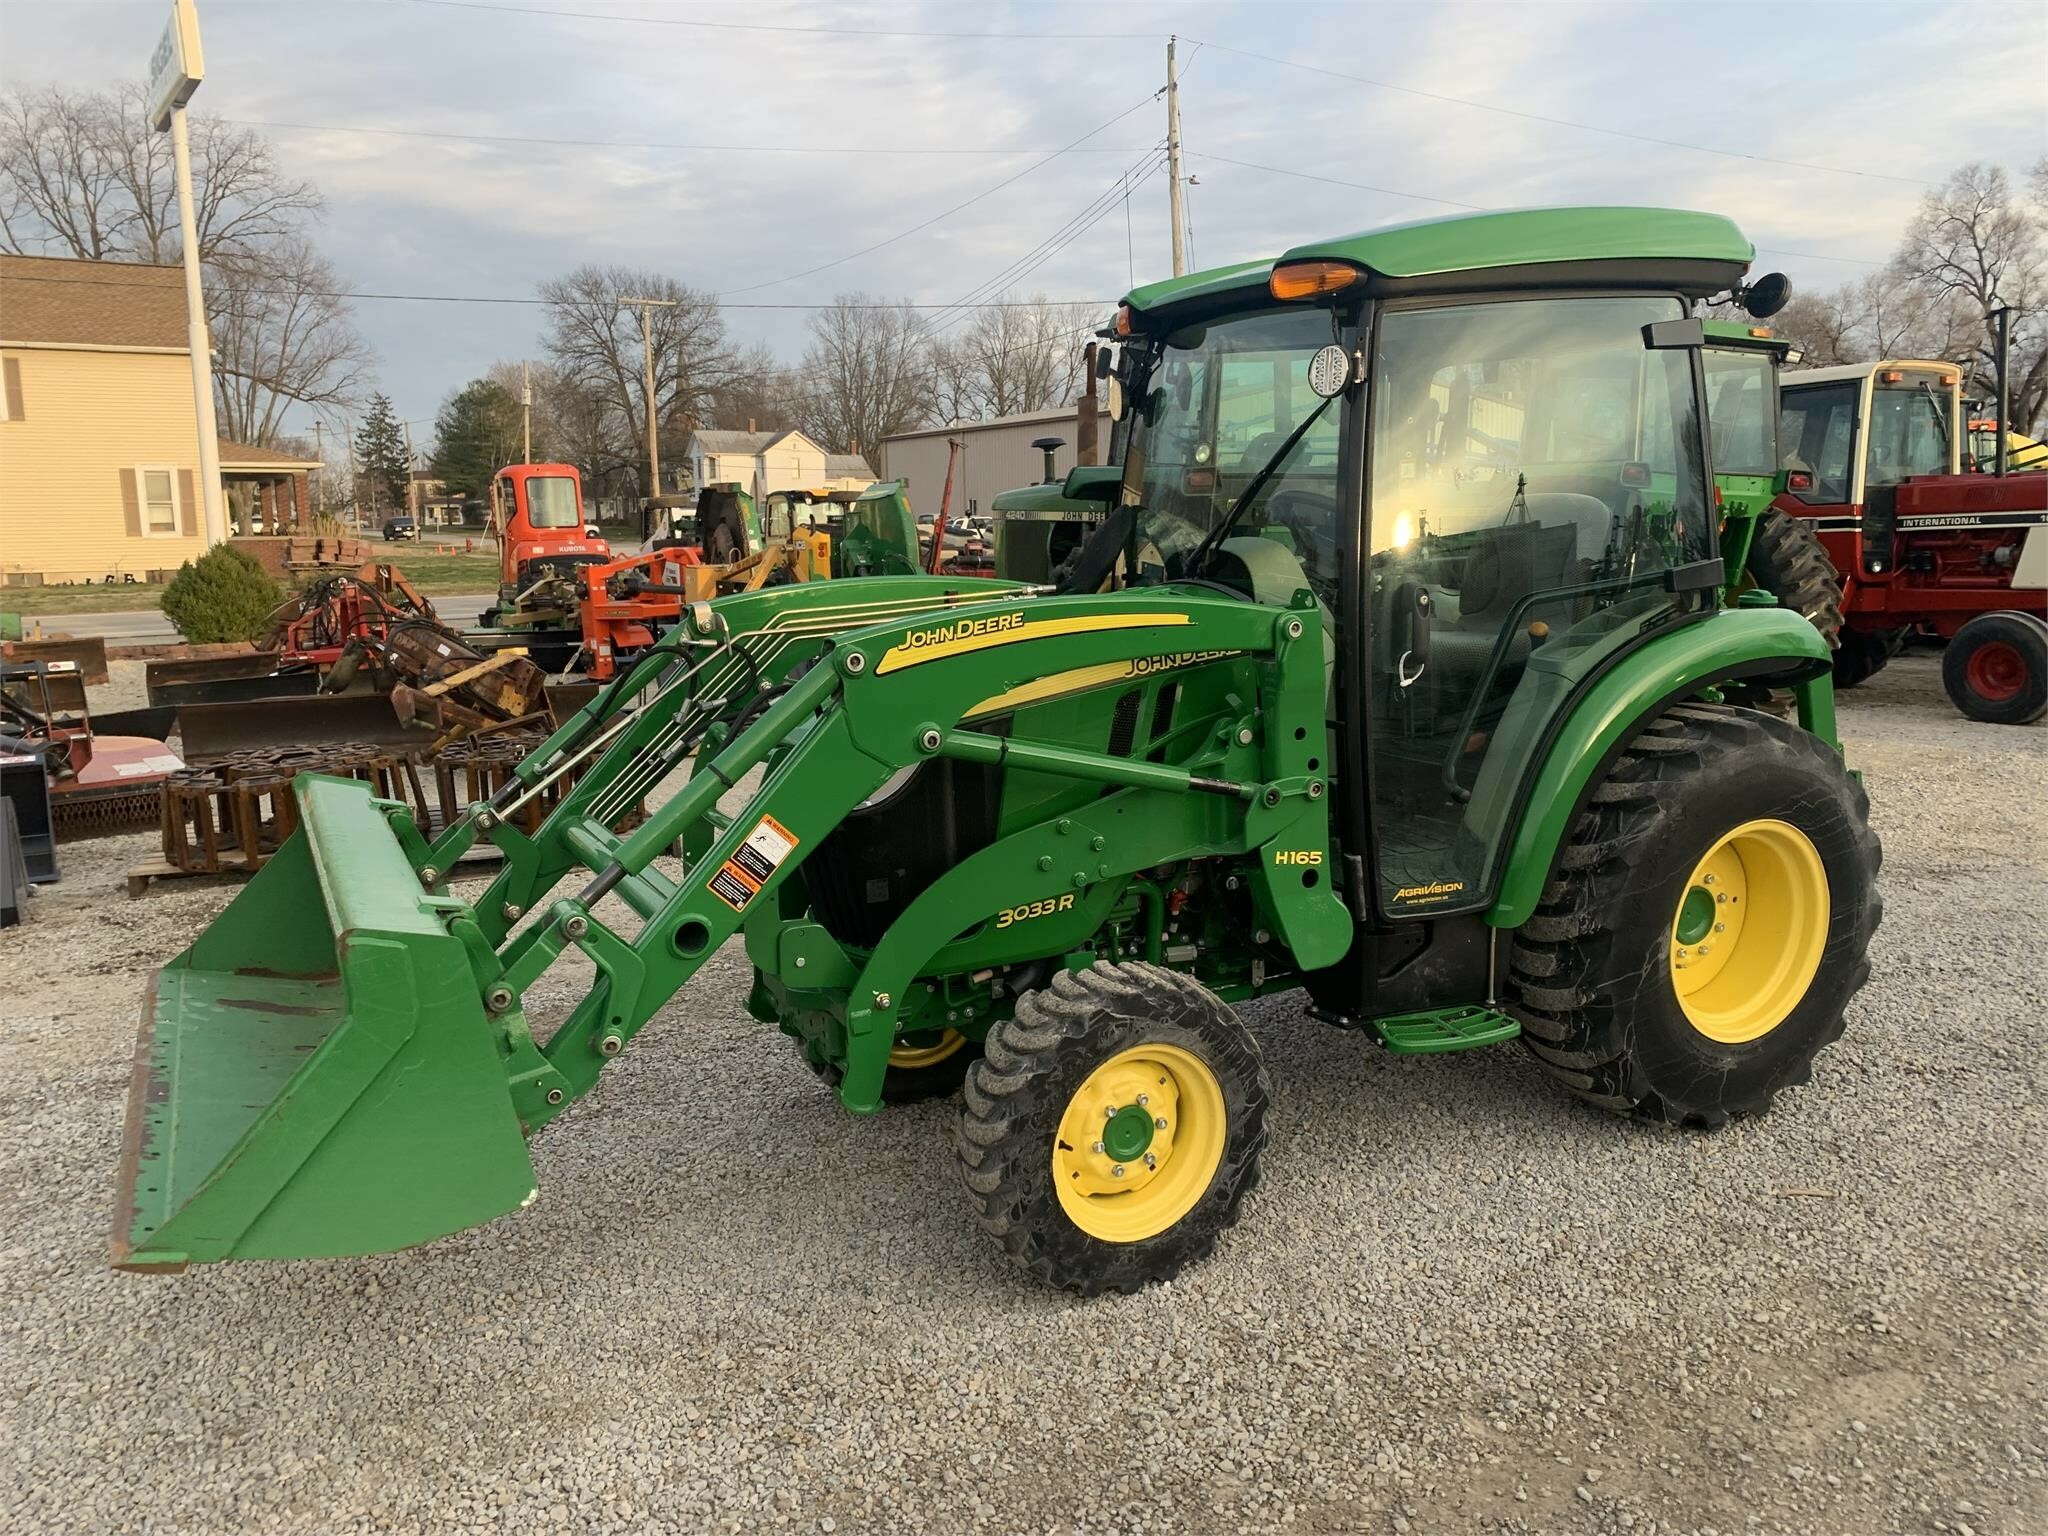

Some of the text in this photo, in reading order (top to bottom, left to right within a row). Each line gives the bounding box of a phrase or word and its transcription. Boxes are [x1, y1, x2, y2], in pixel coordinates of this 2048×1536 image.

[1005, 510, 1026, 520] 4240
[1062, 511, 1105, 520] JOHN DEE
[1903, 517, 1982, 527] INTERNATIONAL
[898, 612, 1025, 651] JOHN DEERE
[1125, 654, 1179, 678] JOHN
[1275, 851, 1323, 866] H165
